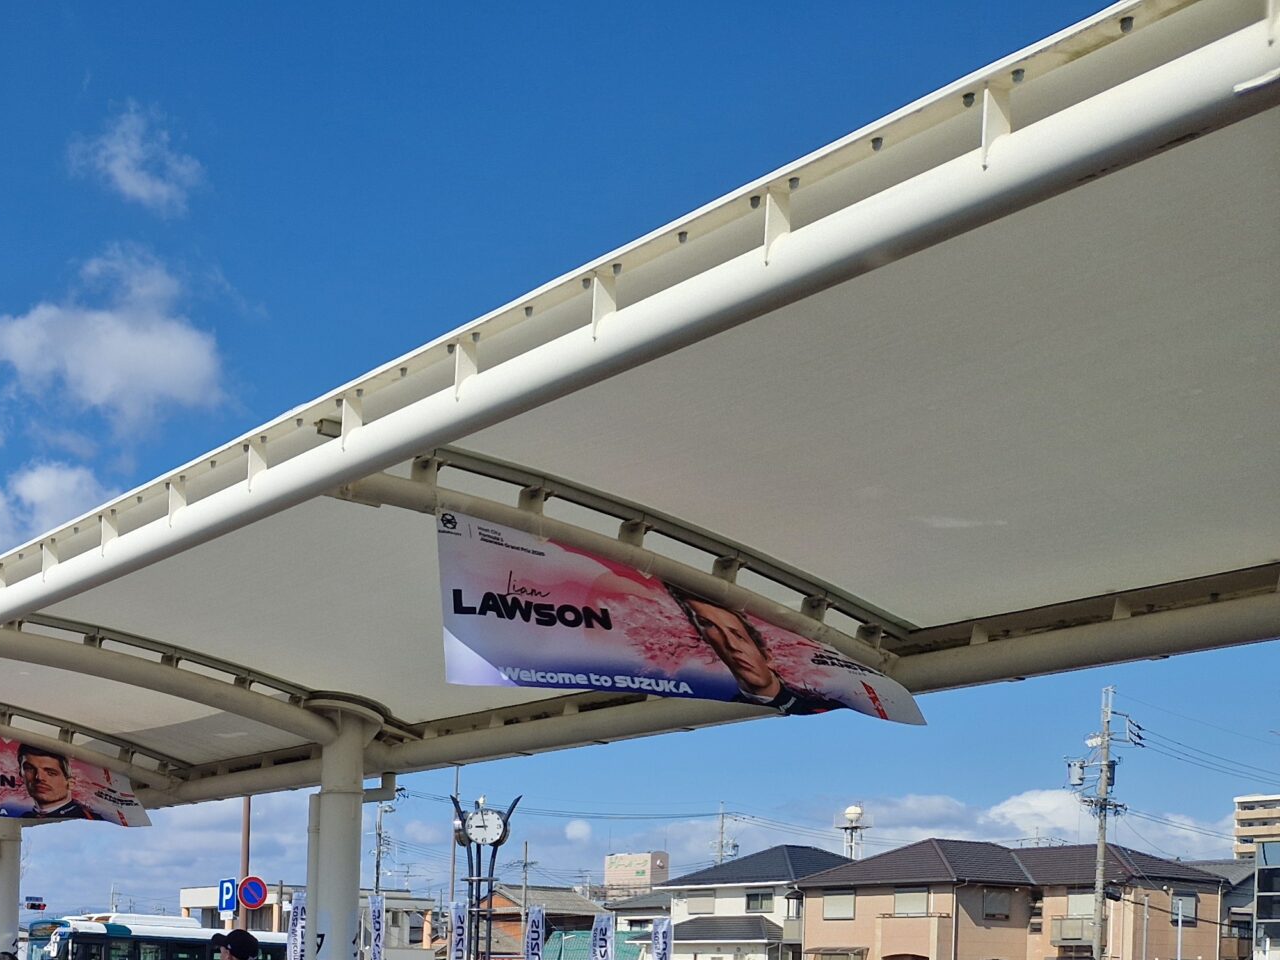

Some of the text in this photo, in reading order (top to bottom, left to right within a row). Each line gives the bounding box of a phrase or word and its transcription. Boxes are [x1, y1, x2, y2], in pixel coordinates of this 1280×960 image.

[504, 570, 550, 598] Liam
[452, 589, 612, 630] LAWSON
[498, 665, 694, 695] Welcome to SUZUKA
[222, 882, 233, 908] P
